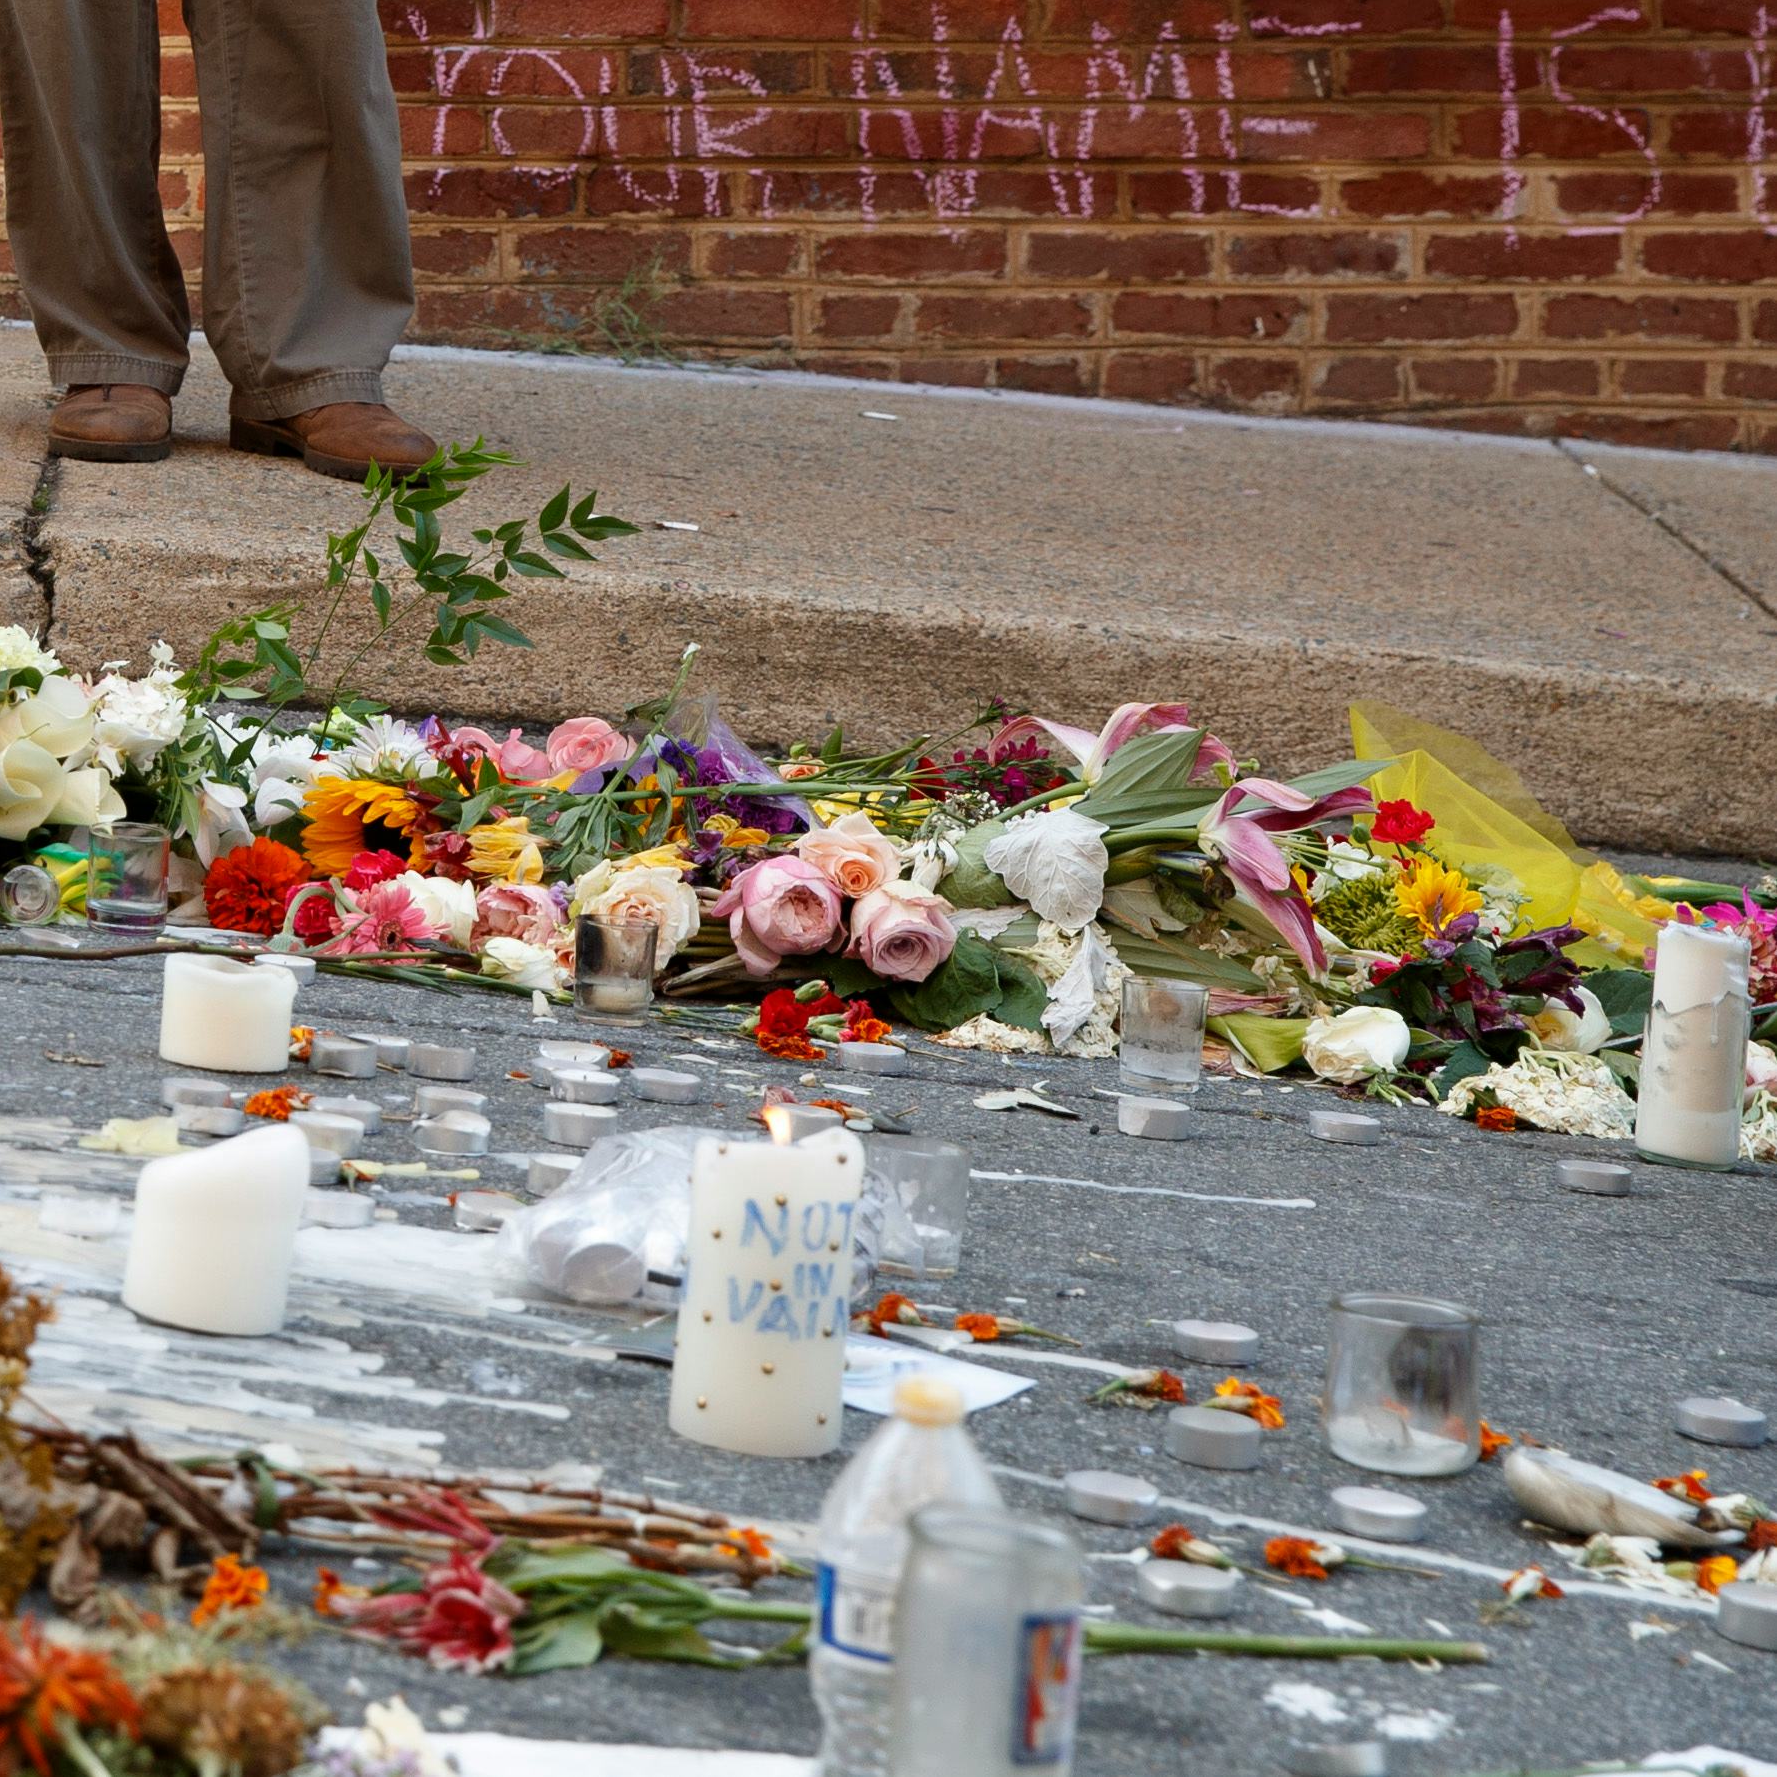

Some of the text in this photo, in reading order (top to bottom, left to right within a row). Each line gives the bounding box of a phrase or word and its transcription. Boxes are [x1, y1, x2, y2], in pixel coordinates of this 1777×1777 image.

[850, 3, 1361, 225] NAME
[1499, 9, 1662, 251] IS
[739, 1198, 856, 1257] NOT
[794, 1262, 835, 1298] IN
